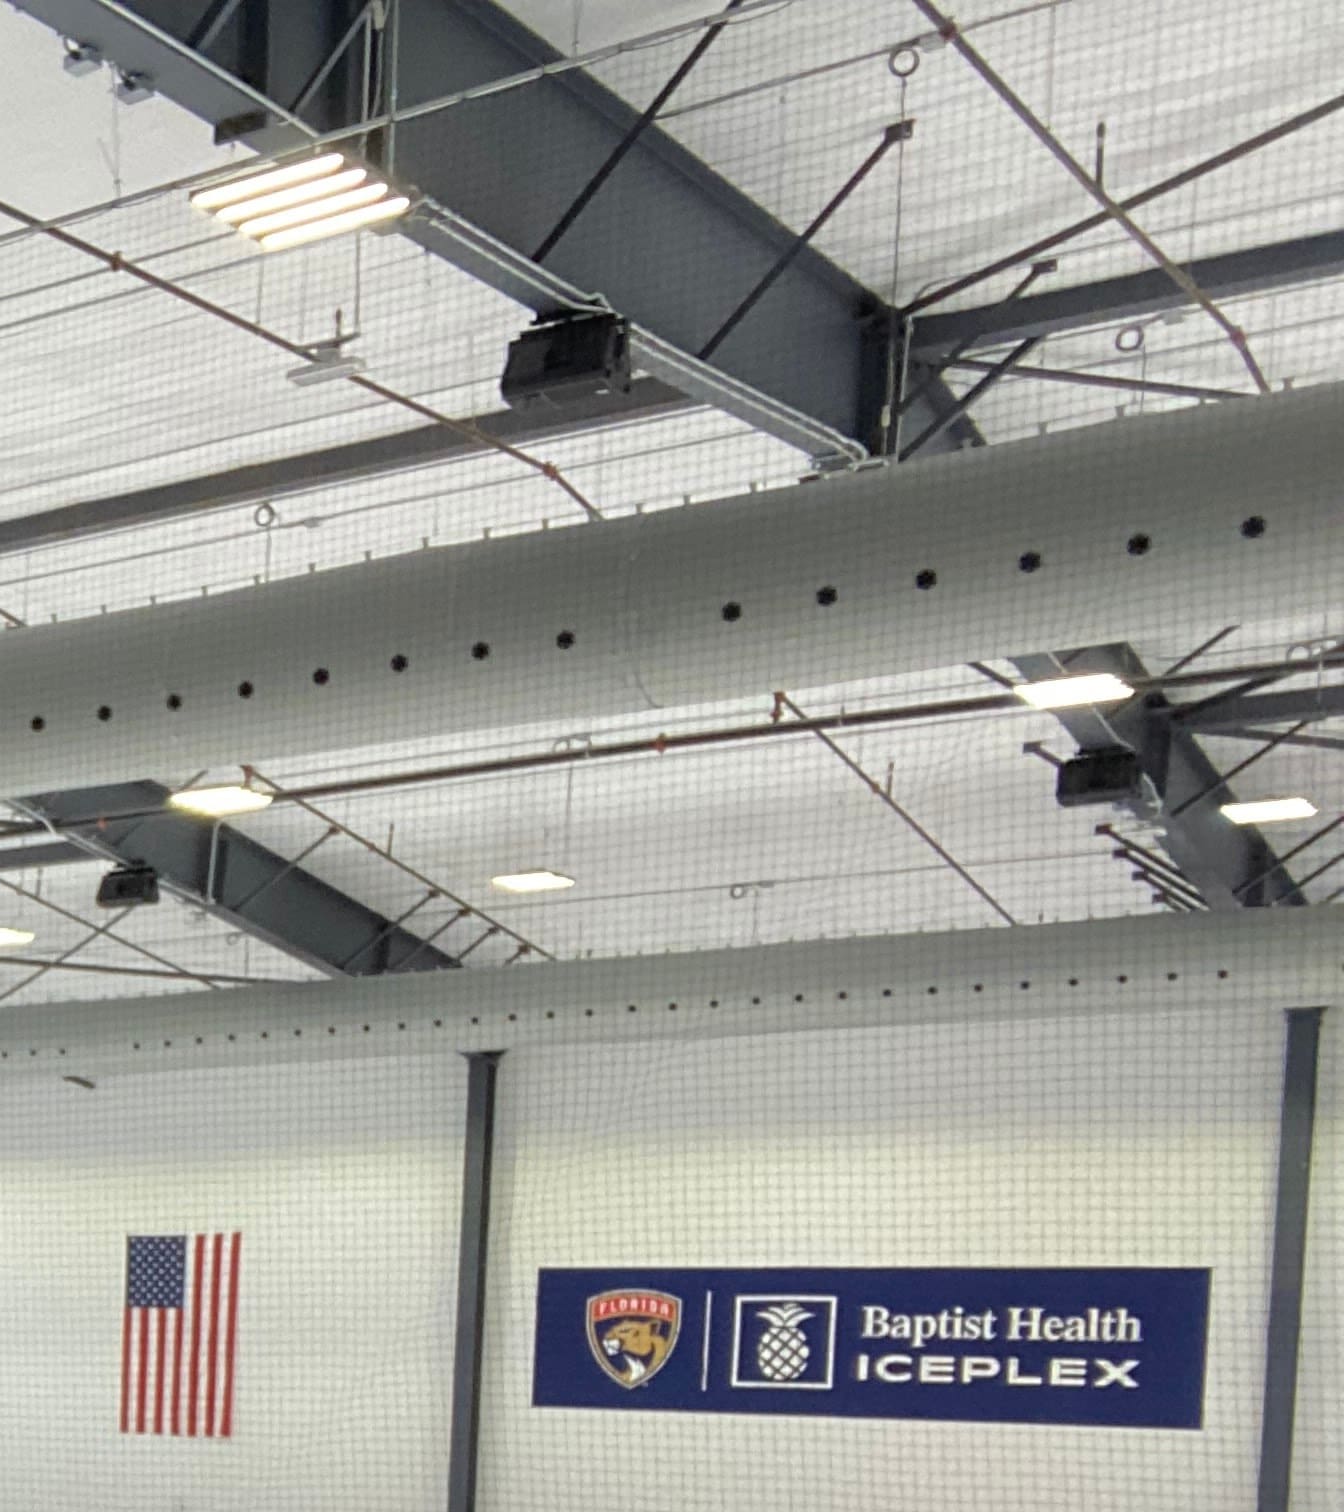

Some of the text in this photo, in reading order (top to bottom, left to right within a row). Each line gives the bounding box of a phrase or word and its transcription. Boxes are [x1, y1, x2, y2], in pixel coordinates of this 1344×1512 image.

[598, 1297, 670, 1316] FLORIDA
[861, 1305, 1144, 1348] Baptist Health
[856, 1353, 1141, 1388] ICEPLEX
